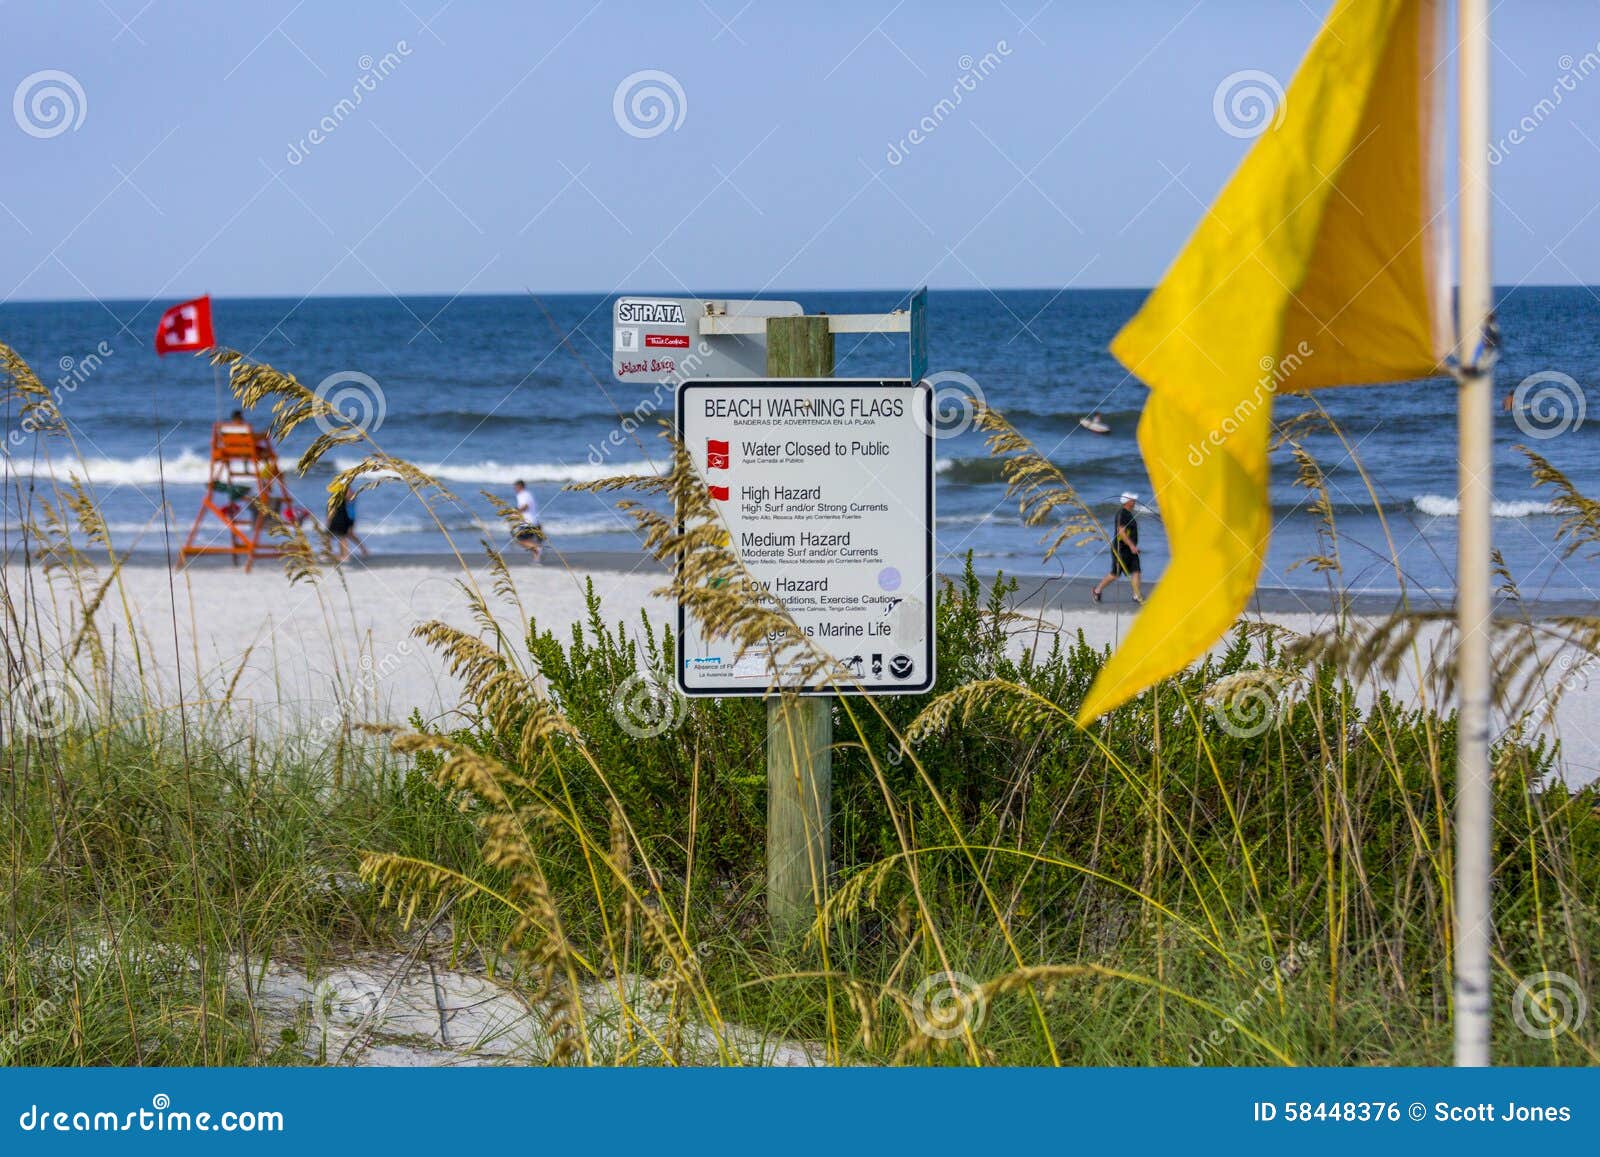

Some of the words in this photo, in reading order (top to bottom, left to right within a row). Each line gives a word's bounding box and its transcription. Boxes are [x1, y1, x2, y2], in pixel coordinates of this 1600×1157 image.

[620, 303, 685, 323] STRATA
[705, 399, 762, 417] BEACH
[767, 399, 845, 417] WARNING
[851, 399, 904, 417] FLAGS
[742, 441, 781, 456] Water
[785, 441, 831, 456] Closed
[835, 442, 847, 456] to
[852, 441, 890, 456] Public
[742, 486, 770, 503] High
[774, 486, 821, 500] Hazard
[742, 503, 761, 514] High
[764, 503, 784, 512] Surf
[786, 503, 815, 512] and/or
[817, 503, 848, 513] Strong
[850, 503, 889, 512] Currents
[742, 532, 796, 547] Medium
[800, 532, 850, 546] Hazard
[742, 548, 785, 557] Moderate
[787, 548, 807, 557] Surf
[809, 548, 838, 557] and/or
[840, 547, 879, 556] Currents
[742, 577, 771, 592] Low
[776, 577, 828, 592] Hazard
[820, 595, 859, 604] Exercise
[861, 594, 896, 604] Caution
[819, 622, 864, 637] Marine
[868, 621, 892, 636] Life
